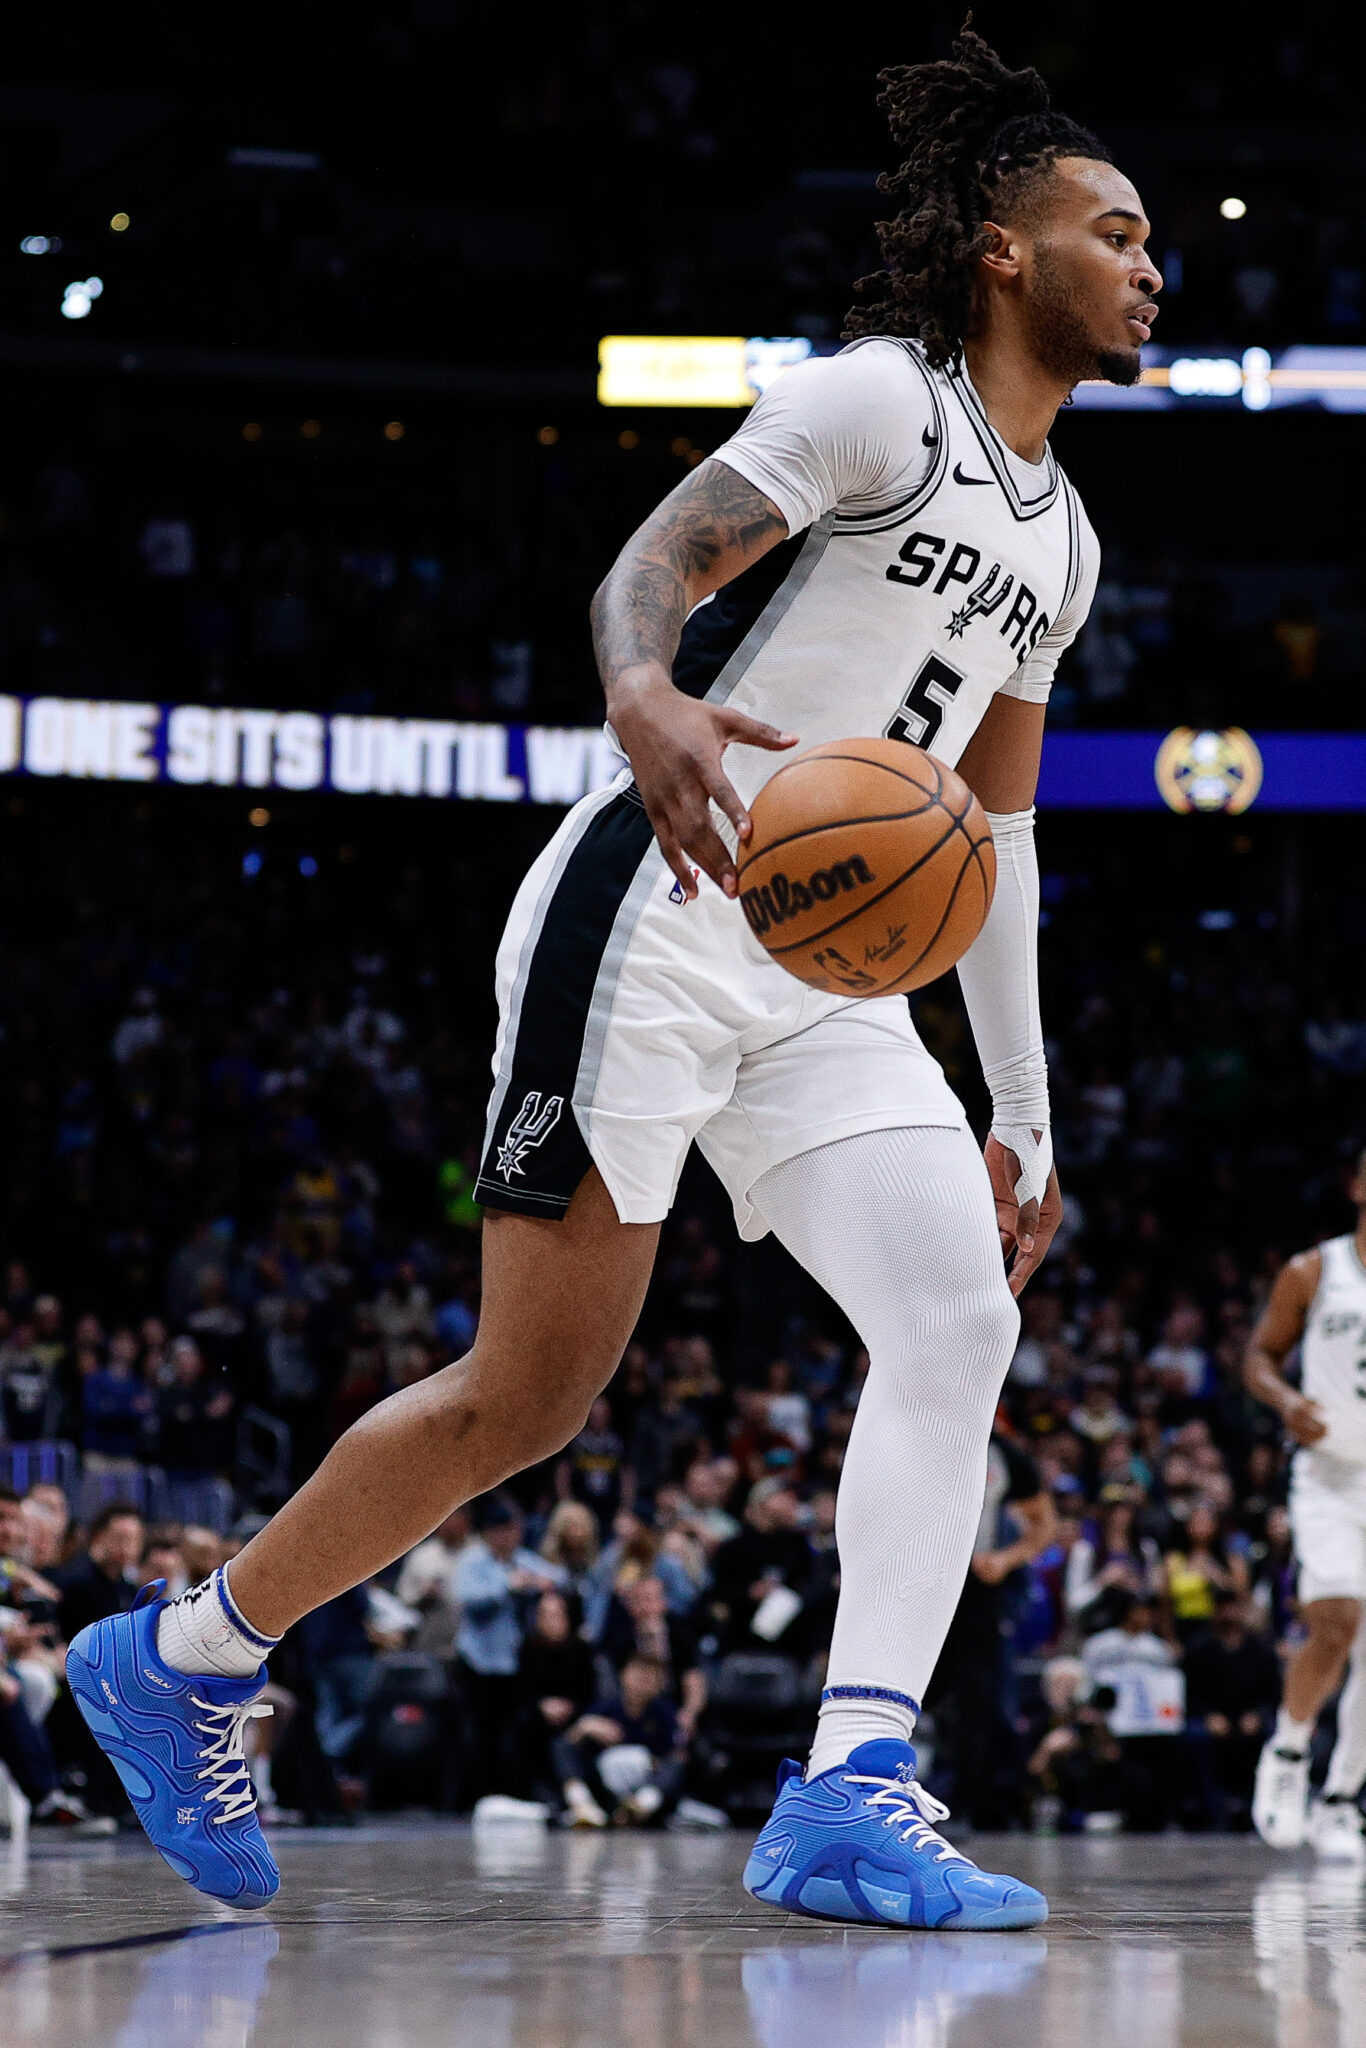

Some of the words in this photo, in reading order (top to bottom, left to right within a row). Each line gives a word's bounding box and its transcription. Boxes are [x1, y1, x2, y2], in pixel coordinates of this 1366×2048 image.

[885, 531, 1050, 666] SPURS
[25, 698, 158, 780] ONE
[167, 704, 323, 791] SITS
[330, 716, 521, 800] UNTIL
[882, 650, 968, 754] 5
[740, 854, 876, 936] Wilson
